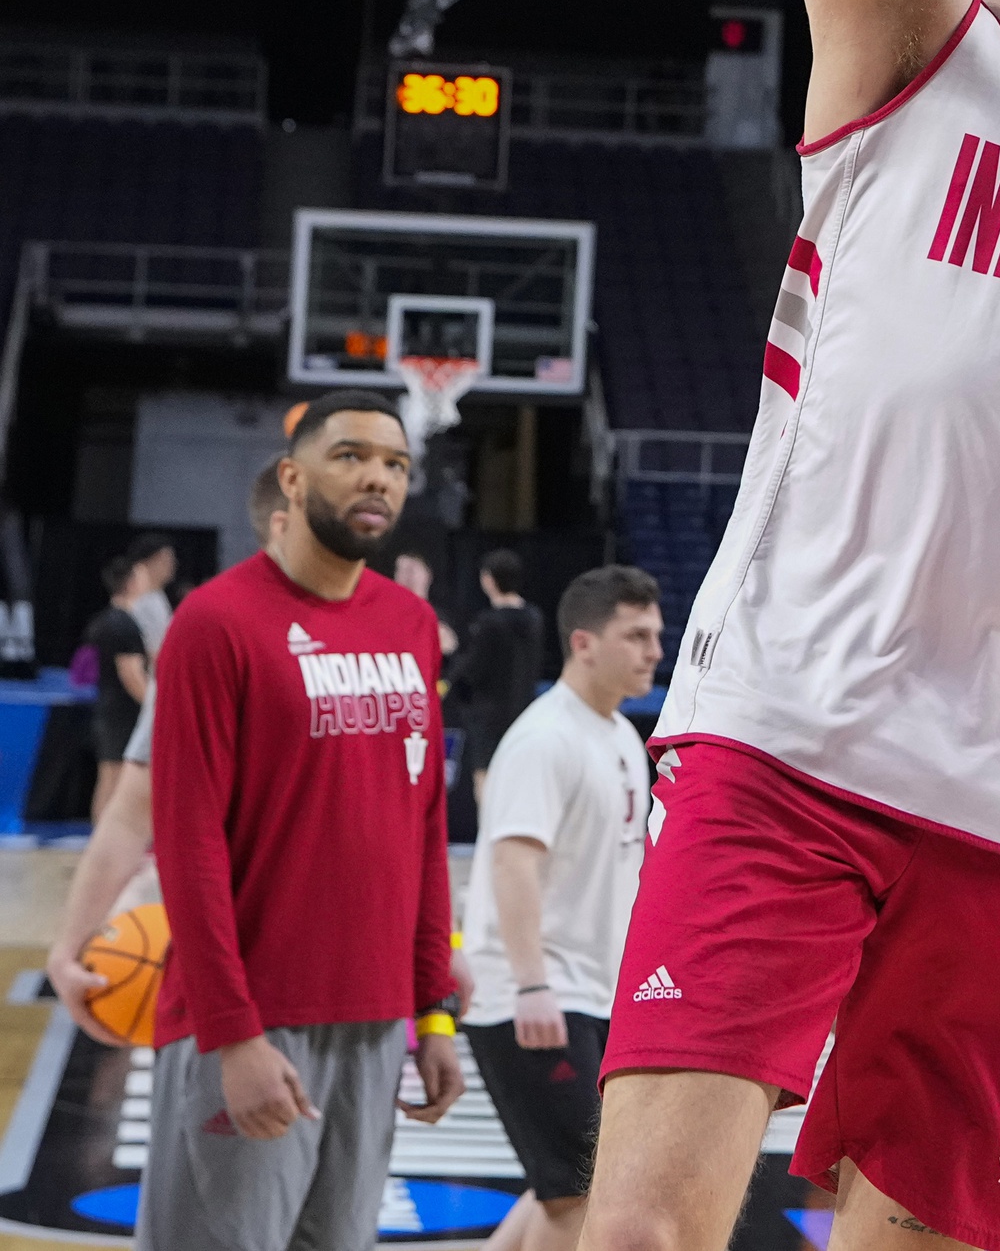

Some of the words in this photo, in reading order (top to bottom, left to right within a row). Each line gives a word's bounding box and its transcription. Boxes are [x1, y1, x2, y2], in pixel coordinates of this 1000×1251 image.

[402, 73, 499, 117] 36:30
[298, 652, 427, 699] INDIANA
[310, 691, 430, 738] HOOPS
[633, 986, 682, 1002] adidas
